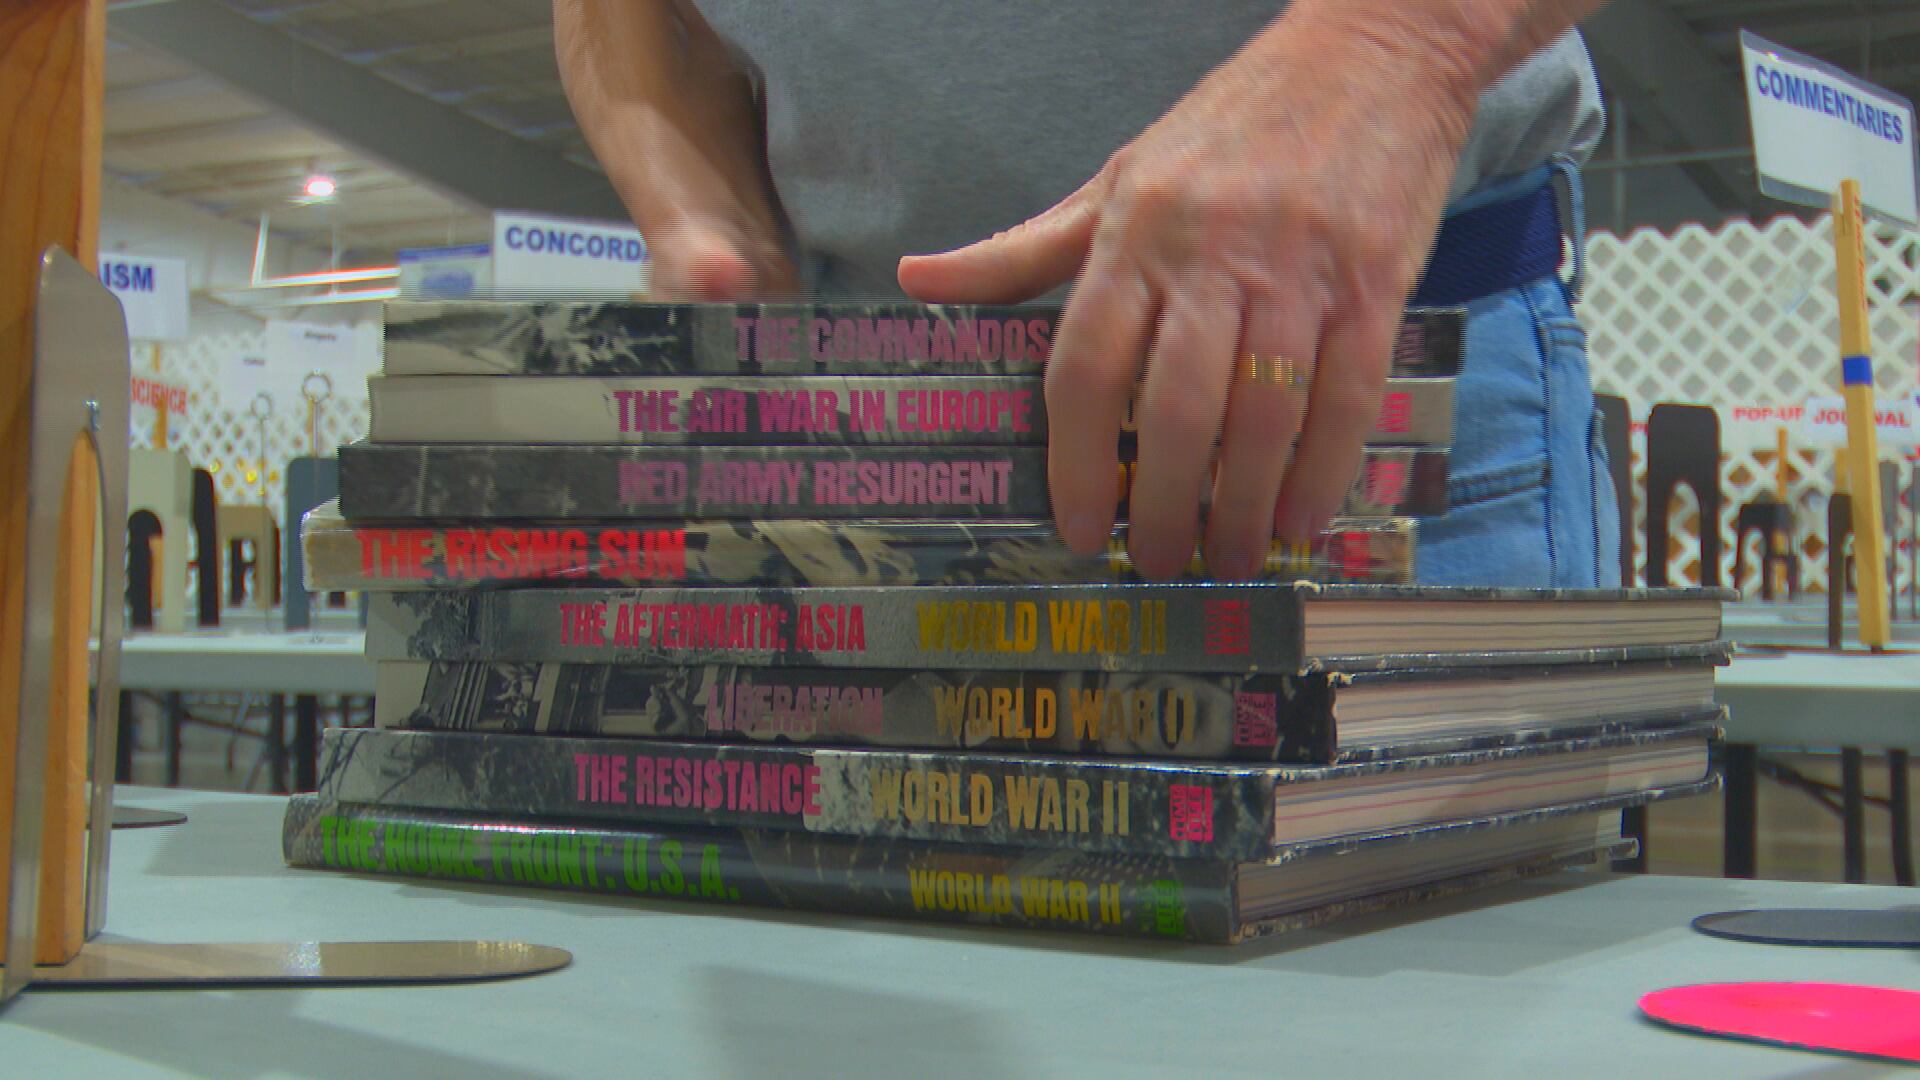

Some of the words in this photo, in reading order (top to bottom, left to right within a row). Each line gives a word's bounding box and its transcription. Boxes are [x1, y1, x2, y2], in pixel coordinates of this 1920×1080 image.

[1756, 64, 1903, 144] COMMENTARIES
[504, 226, 646, 262] CONCORD
[733, 318, 799, 362] THE
[810, 318, 1049, 363] COMMANDOS
[614, 390, 680, 433] THE
[686, 390, 748, 433] AIR
[758, 390, 839, 433] WAR
[849, 390, 885, 433] IN
[898, 390, 1032, 433] EUROPE
[1733, 407, 1804, 421] POP-UP
[1814, 409, 1910, 427] JONAL
[618, 461, 687, 505] RED
[696, 461, 811, 505] ARMY
[815, 461, 1014, 505] RESURGENT
[354, 528, 435, 579] THE
[442, 529, 588, 579] RISING
[598, 529, 687, 579] SUN
[560, 603, 607, 647] THE
[613, 603, 788, 651] AFTERMATH:
[796, 604, 867, 652] ASIA
[916, 600, 1038, 653] WORLD
[1048, 600, 1131, 654] WAR
[1139, 600, 1166, 654] II
[707, 683, 883, 734] LIBERATION
[933, 686, 1057, 740] WORLD
[1069, 688, 1153, 742] WAR
[1164, 690, 1196, 743] II
[573, 753, 627, 804] THE
[636, 758, 822, 815] RESISTANCE
[869, 769, 994, 827] WORLD
[1005, 775, 1090, 833] WAR
[1103, 780, 1130, 836] II
[320, 816, 378, 868] THE
[383, 821, 485, 878] HOME
[490, 832, 616, 889] FRONT:
[622, 838, 740, 899] U.S.A.
[909, 869, 1012, 912] WORLD
[1021, 874, 1089, 920] WAR
[1100, 883, 1121, 924] II
